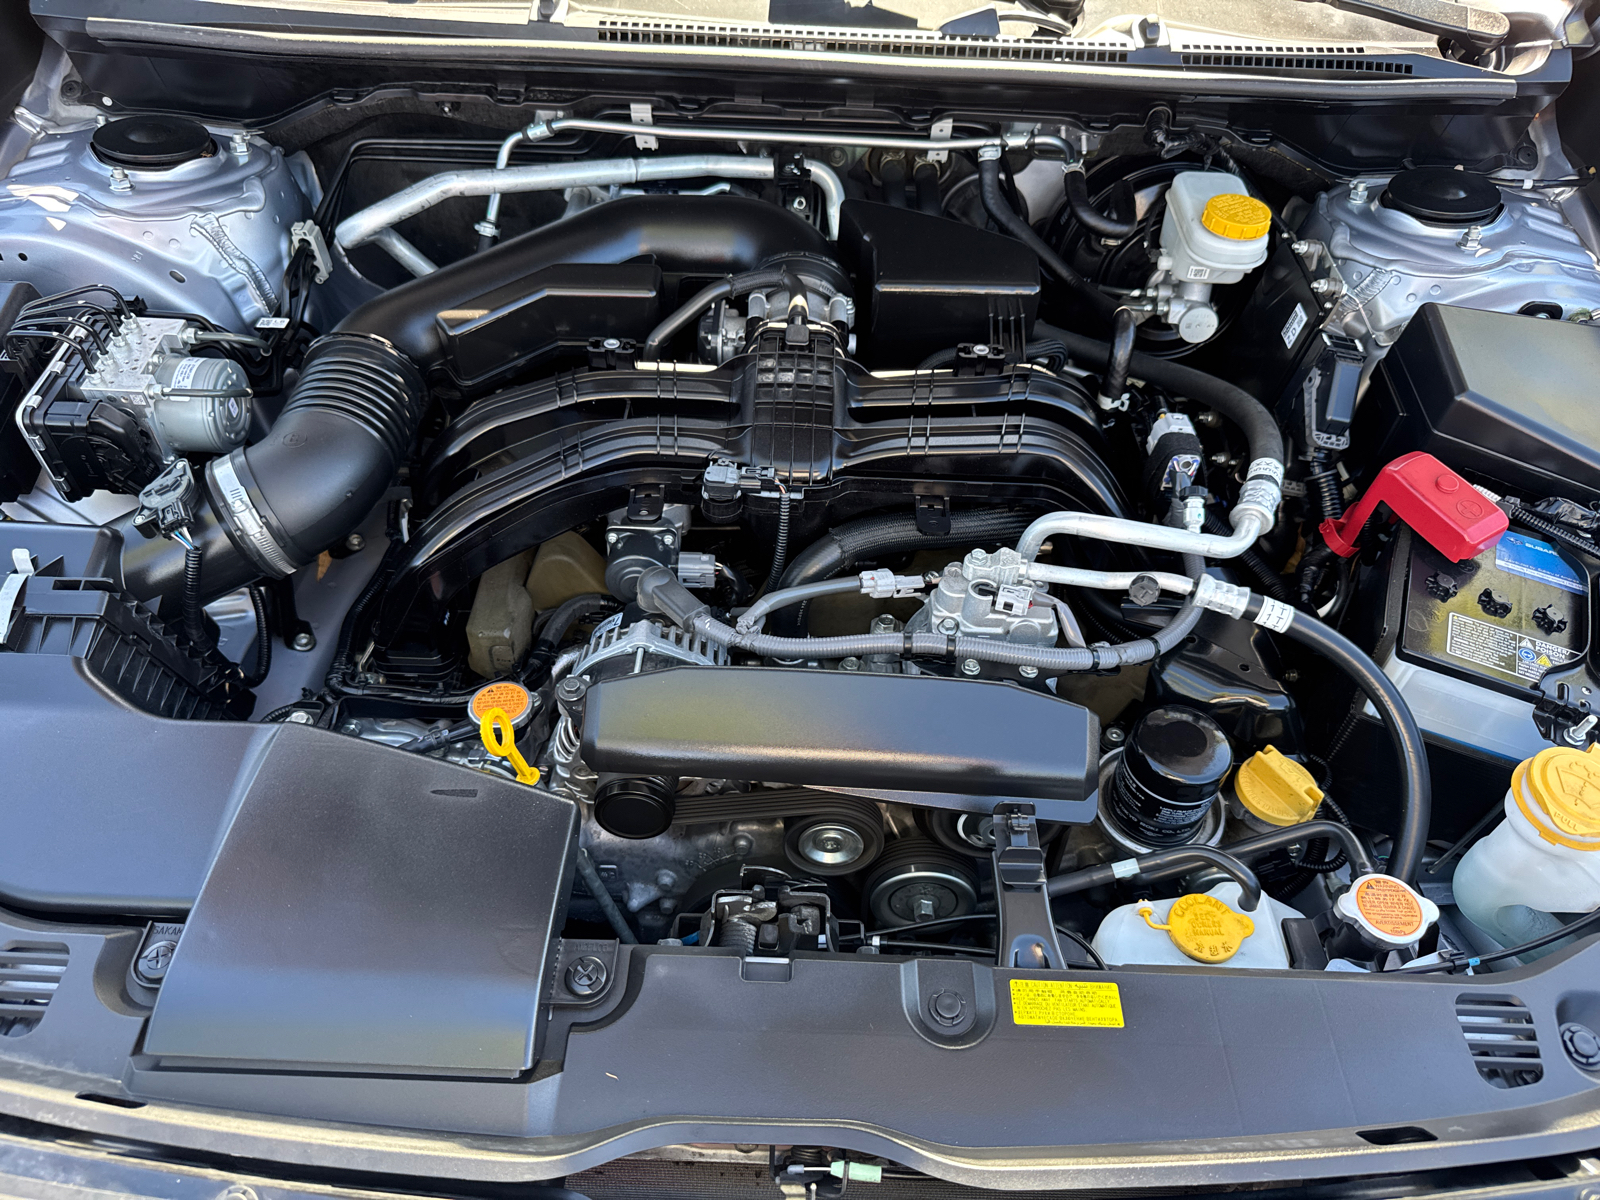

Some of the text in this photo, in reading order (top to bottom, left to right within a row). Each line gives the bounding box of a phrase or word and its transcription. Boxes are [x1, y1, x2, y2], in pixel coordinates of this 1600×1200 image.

[1536, 646, 1565, 659] POISON
[1554, 812, 1578, 832] PULL
[1174, 896, 1231, 918] COOLANT
